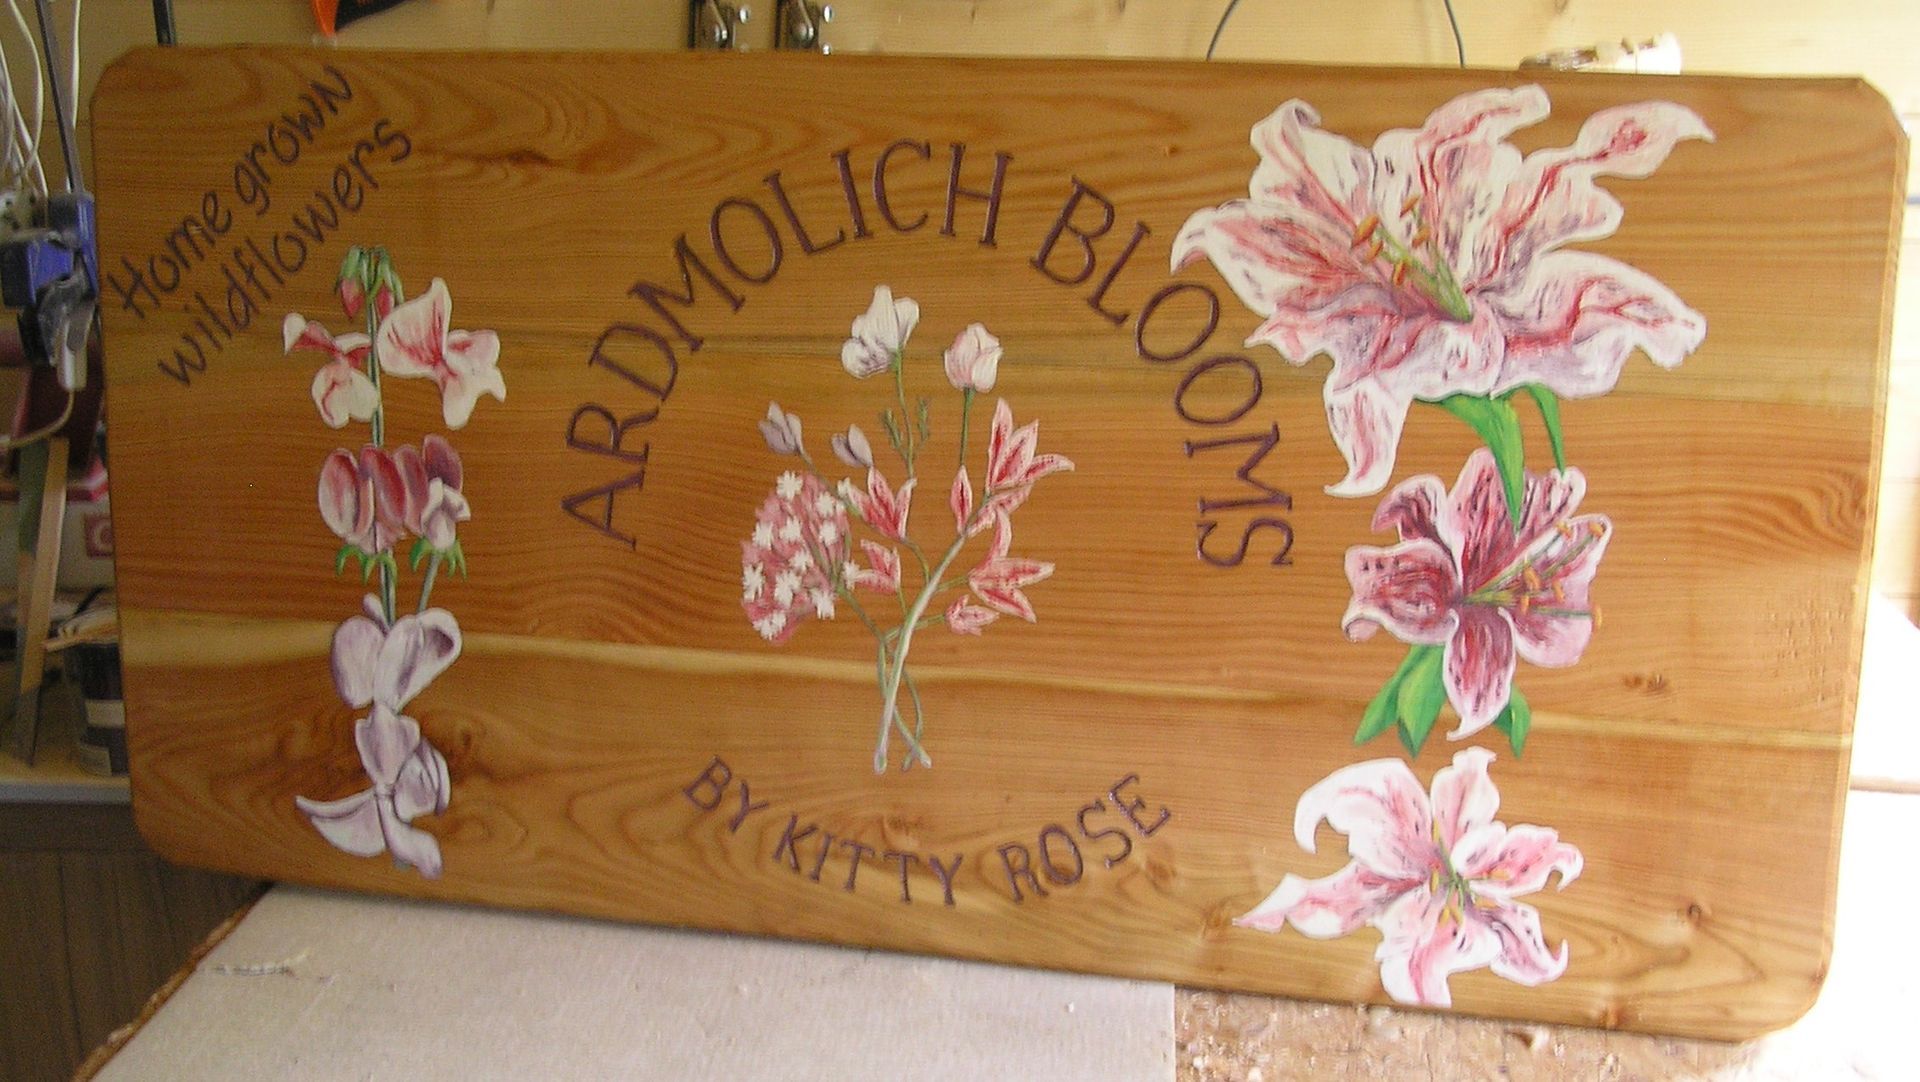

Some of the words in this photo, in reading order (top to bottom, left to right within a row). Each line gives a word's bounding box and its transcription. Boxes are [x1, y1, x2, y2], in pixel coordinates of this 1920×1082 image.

[107, 190, 232, 319] Home
[233, 64, 354, 216] grown
[157, 118, 413, 388] wildflowers
[561, 138, 1014, 551] ARDMOLICH
[1029, 175, 1294, 568] BLOOMS
[682, 755, 769, 833] BY
[772, 812, 965, 907] KITTY
[998, 773, 1171, 904] ROSE
